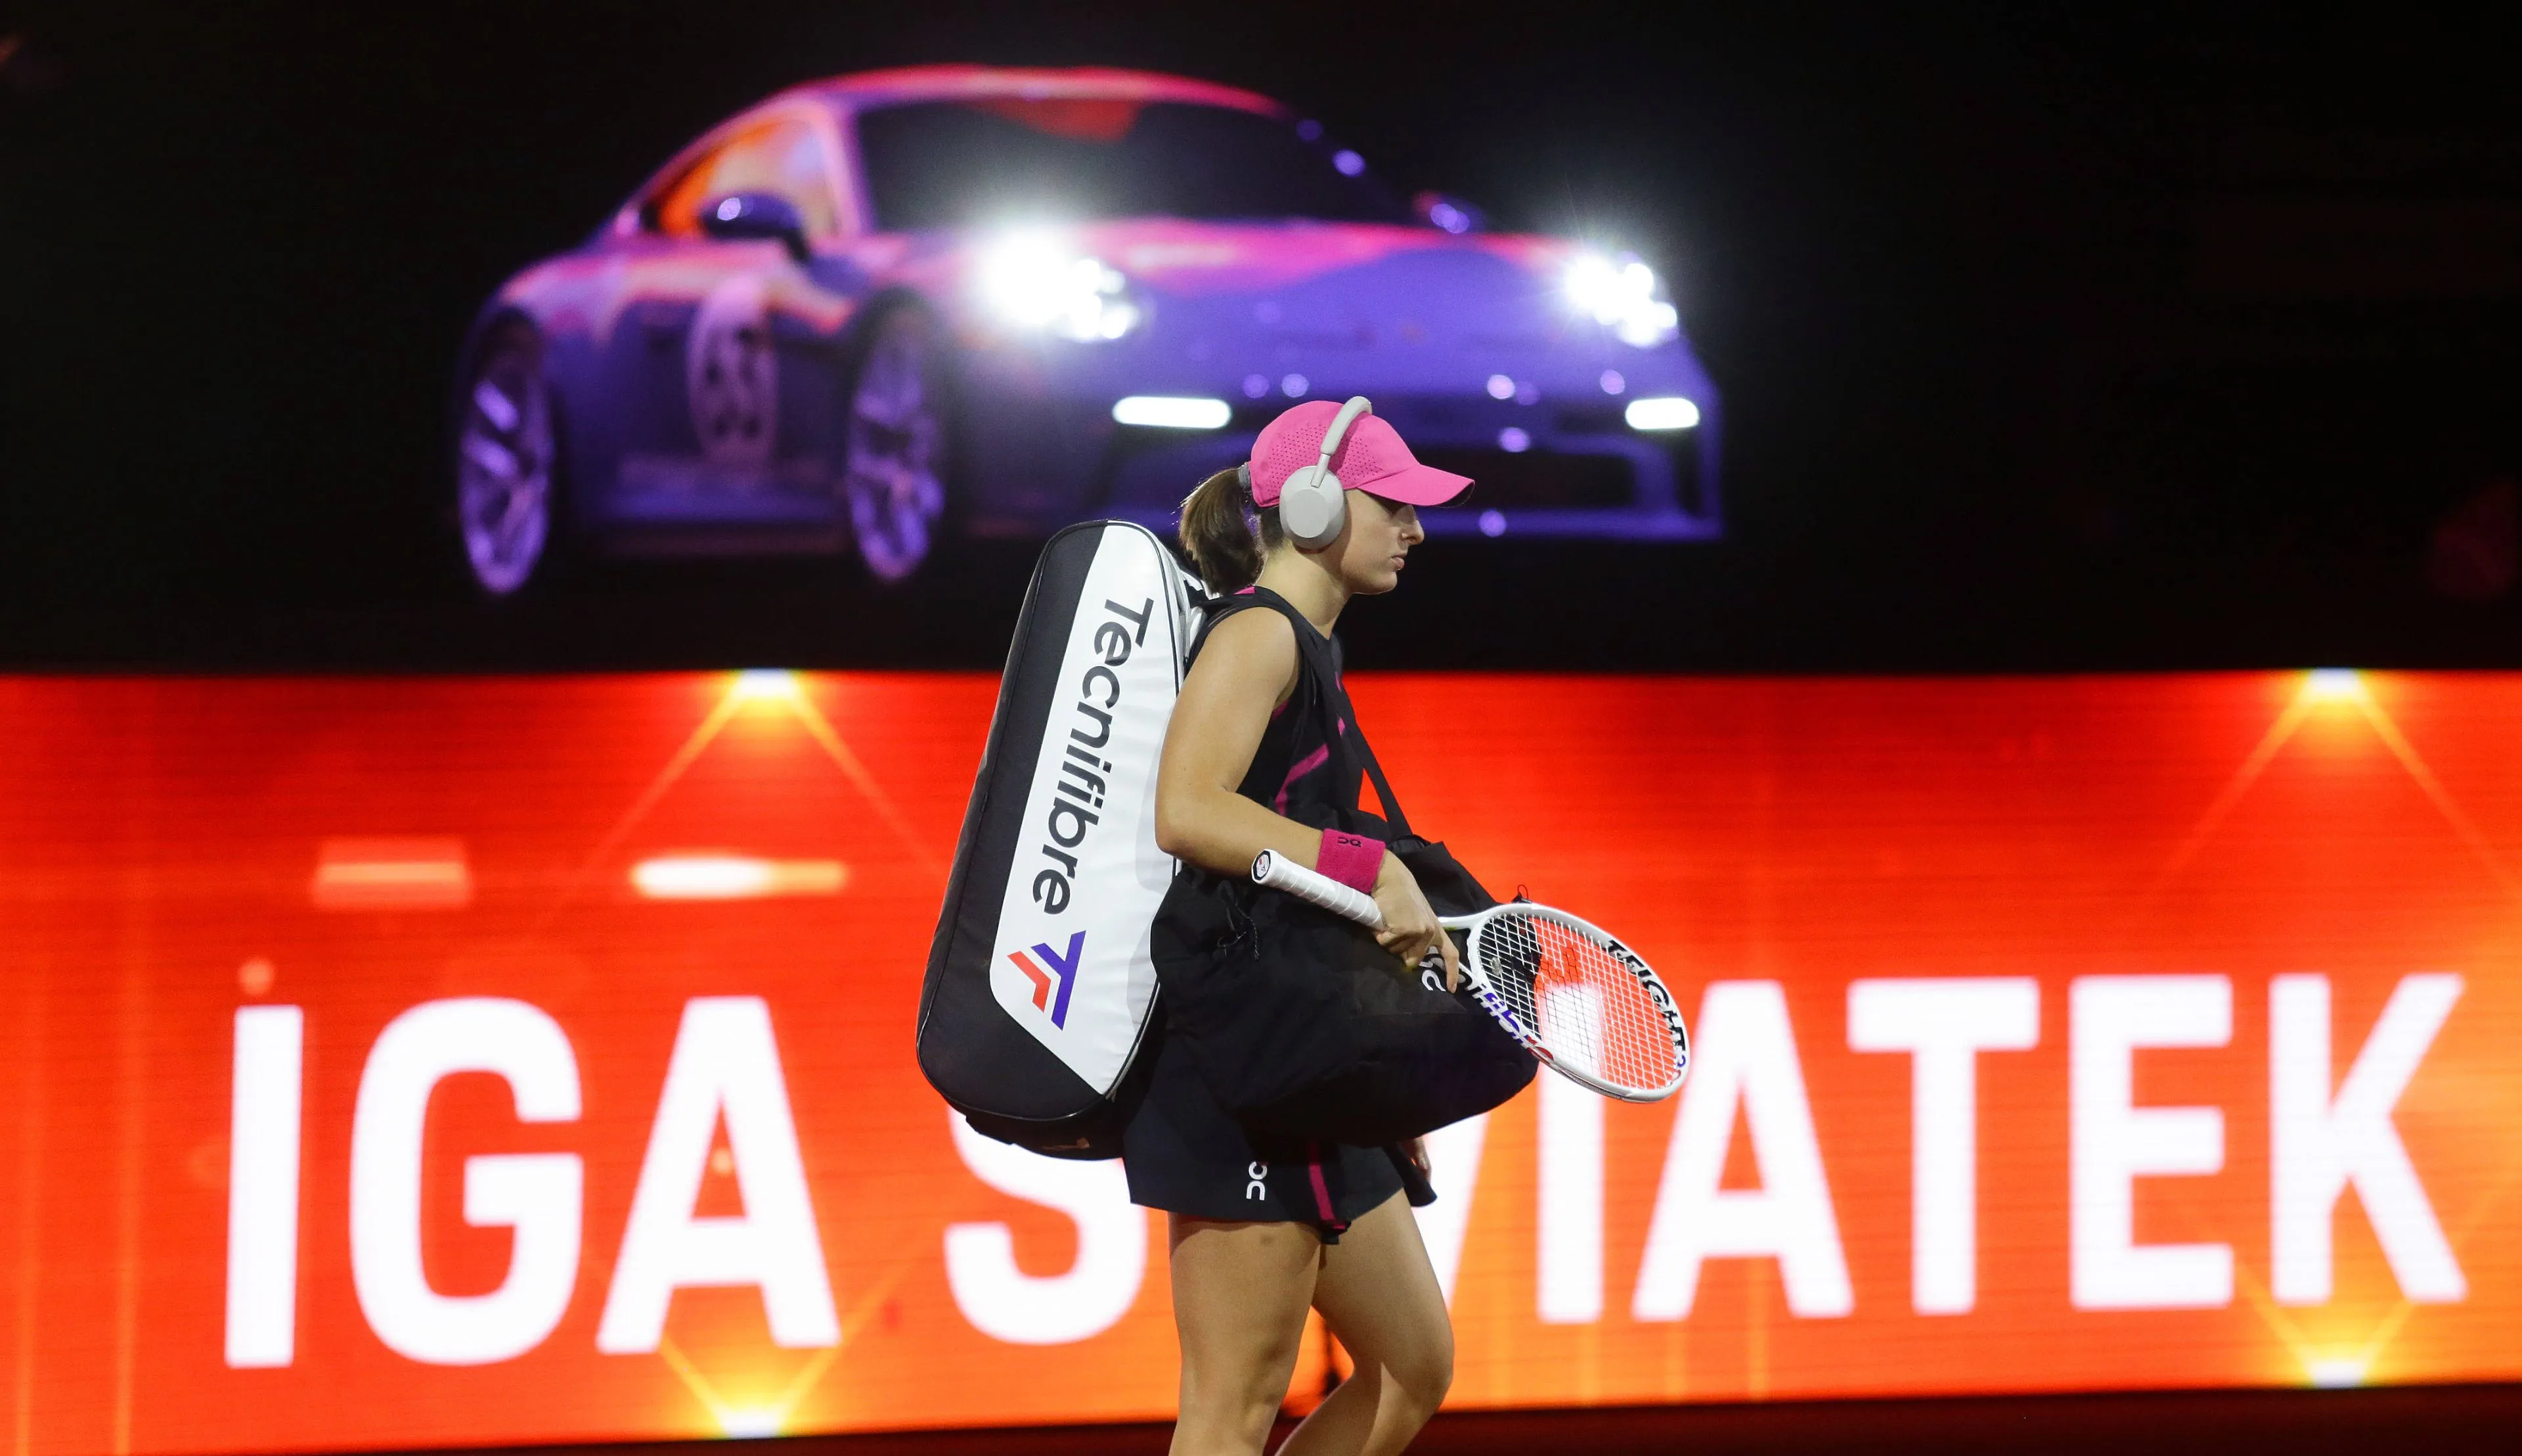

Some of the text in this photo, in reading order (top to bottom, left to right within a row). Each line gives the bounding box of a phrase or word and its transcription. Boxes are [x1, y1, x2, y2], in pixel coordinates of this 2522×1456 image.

[1032, 597, 1154, 915] Tecnifibre
[224, 972, 2467, 1369] IGA SIATEK
